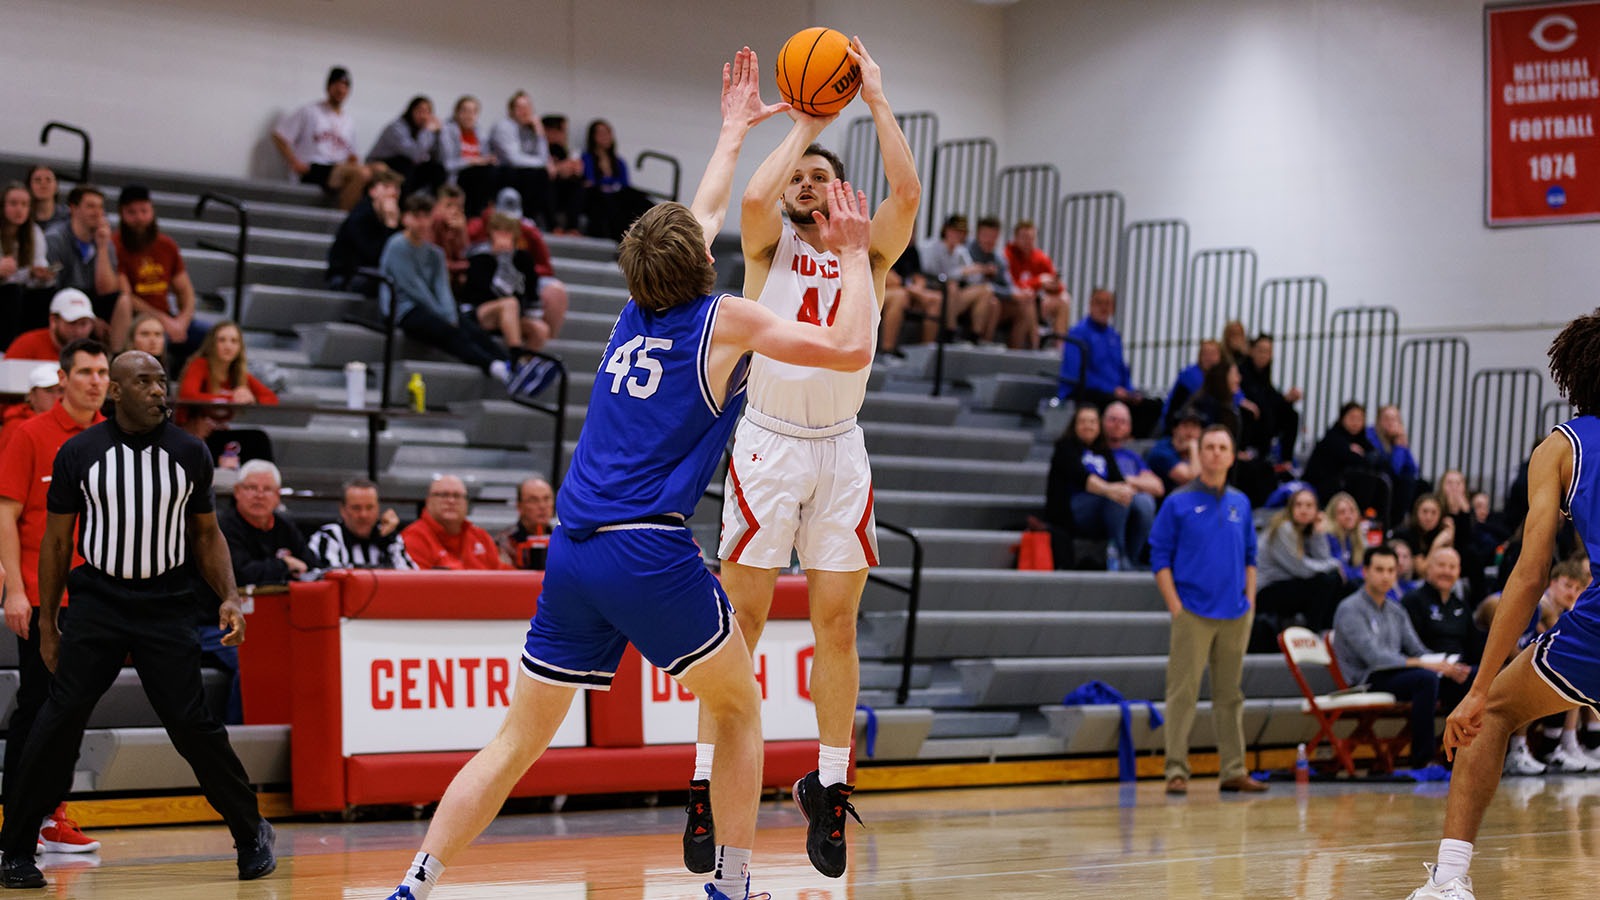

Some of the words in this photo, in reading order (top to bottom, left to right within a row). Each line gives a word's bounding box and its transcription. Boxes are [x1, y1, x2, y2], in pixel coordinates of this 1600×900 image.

[1528, 13, 1578, 53] C
[832, 63, 861, 94] Wil
[1513, 59, 1588, 81] NATIONAL
[1503, 78, 1599, 105] CHAMPIONS
[1509, 115, 1593, 141] FOOTBALL
[1529, 153, 1576, 181] 1974
[605, 334, 673, 400] 45
[370, 657, 511, 710] CENTR
